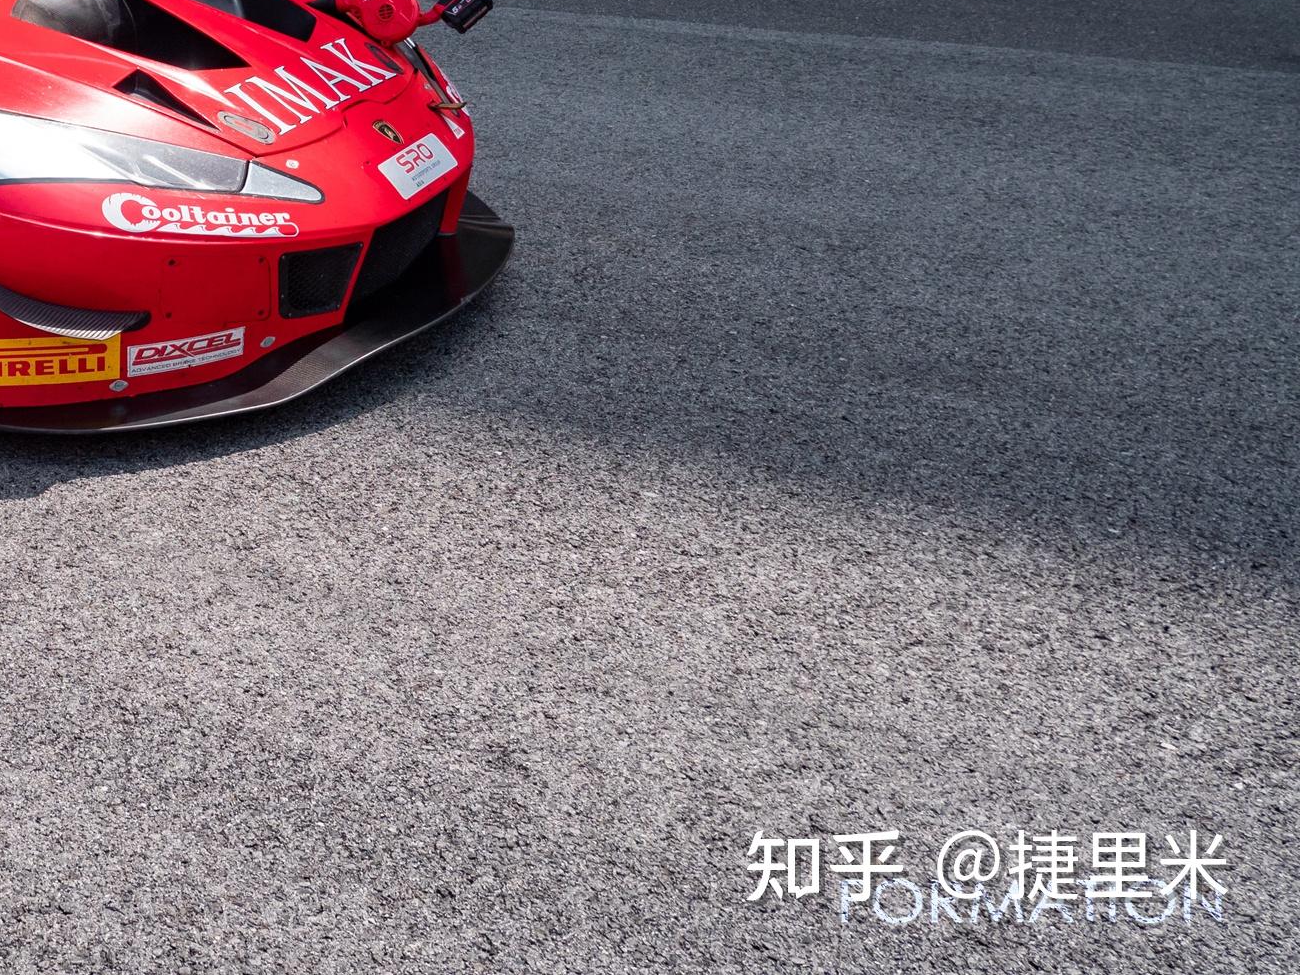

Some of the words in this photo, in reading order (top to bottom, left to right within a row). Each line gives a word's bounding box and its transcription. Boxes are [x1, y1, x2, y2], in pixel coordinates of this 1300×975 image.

[224, 38, 397, 135] IMAK
[395, 142, 434, 174] SRO
[101, 193, 291, 233] Cooltainer
[131, 332, 242, 366] DIXCEL
[131, 360, 171, 374] ADVANCED
[197, 347, 242, 363] TECHNOLOGY
